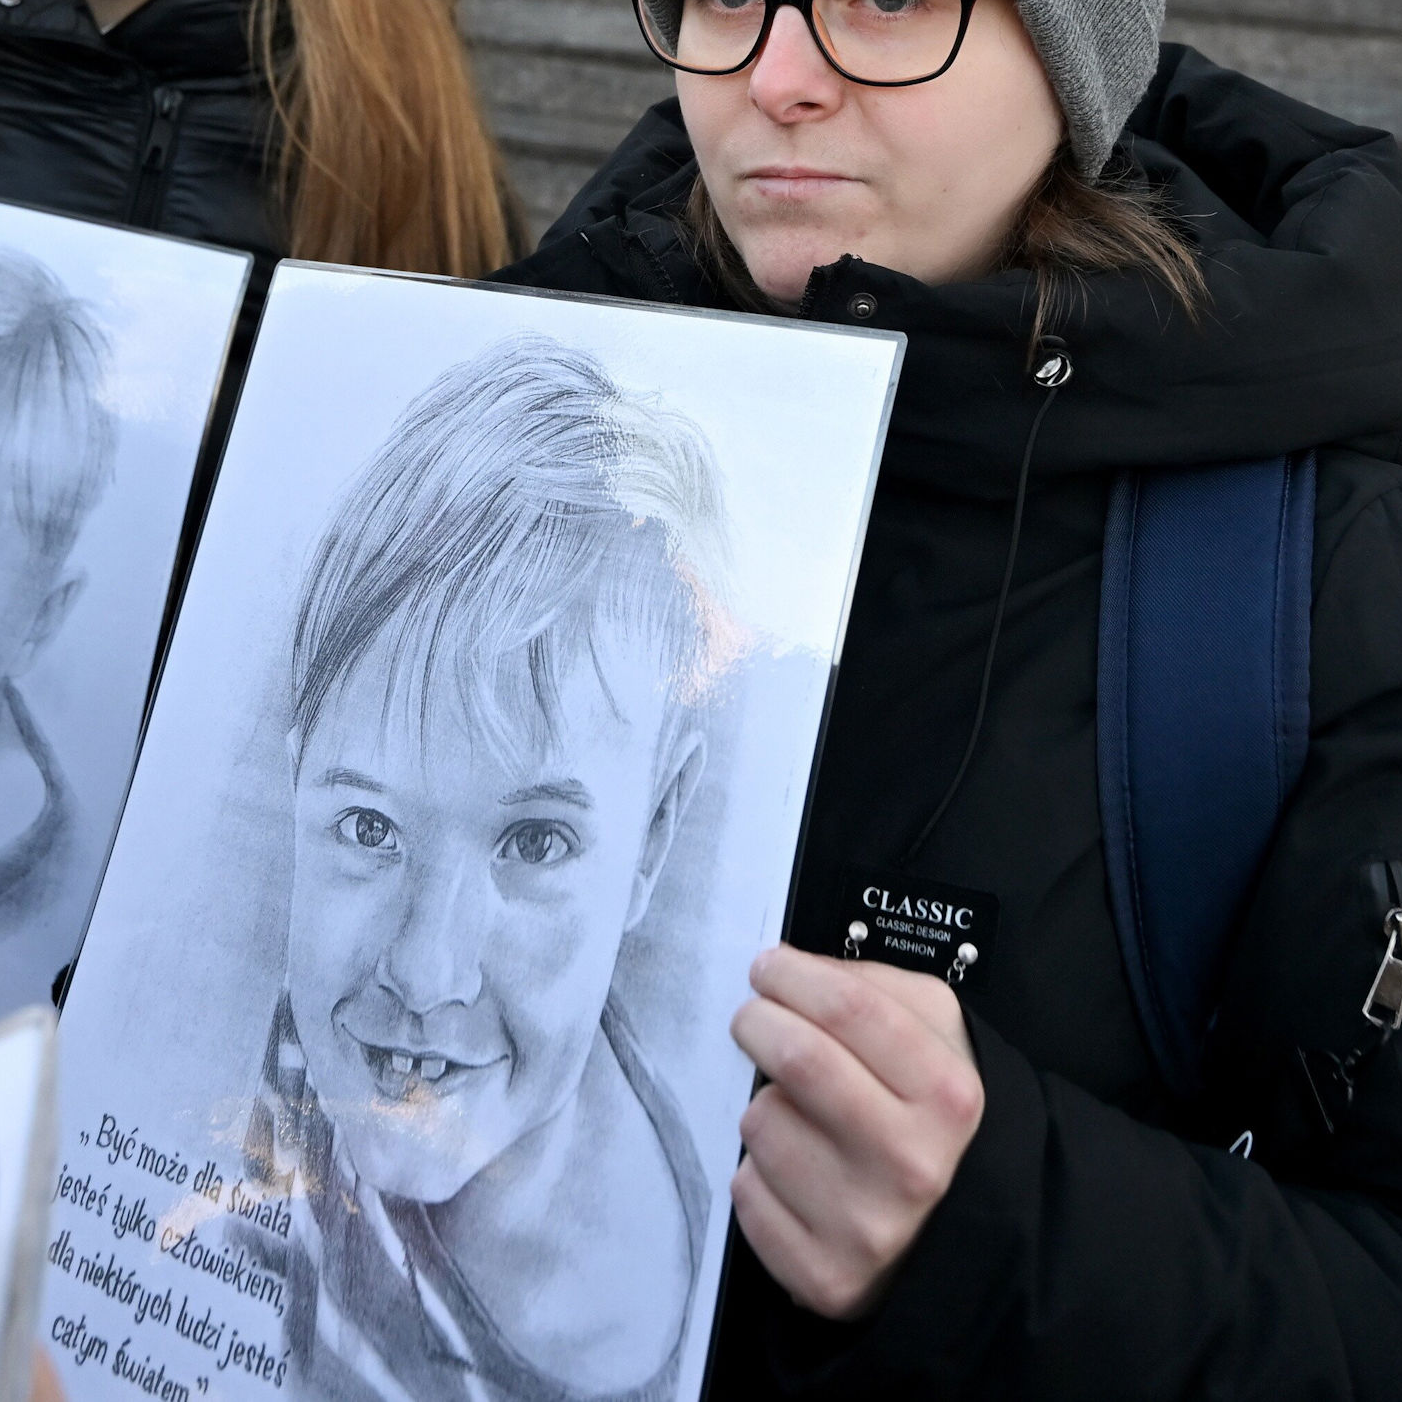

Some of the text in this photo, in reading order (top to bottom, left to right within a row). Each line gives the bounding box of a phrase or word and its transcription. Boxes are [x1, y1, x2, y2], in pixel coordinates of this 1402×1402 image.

[862, 886, 974, 930] CLASSIC
[875, 915, 951, 943] CLASSIC DESIGN
[884, 935, 936, 958] FASHION
[136, 1142, 189, 1185] może
[193, 1161, 223, 1204] dla
[227, 1178, 293, 1239] świata
[55, 1164, 285, 1318] jesteś tylko człowiekiem,
[49, 1230, 292, 1389] dla niektórych ludzi jesteś
[52, 1314, 109, 1367] całym
